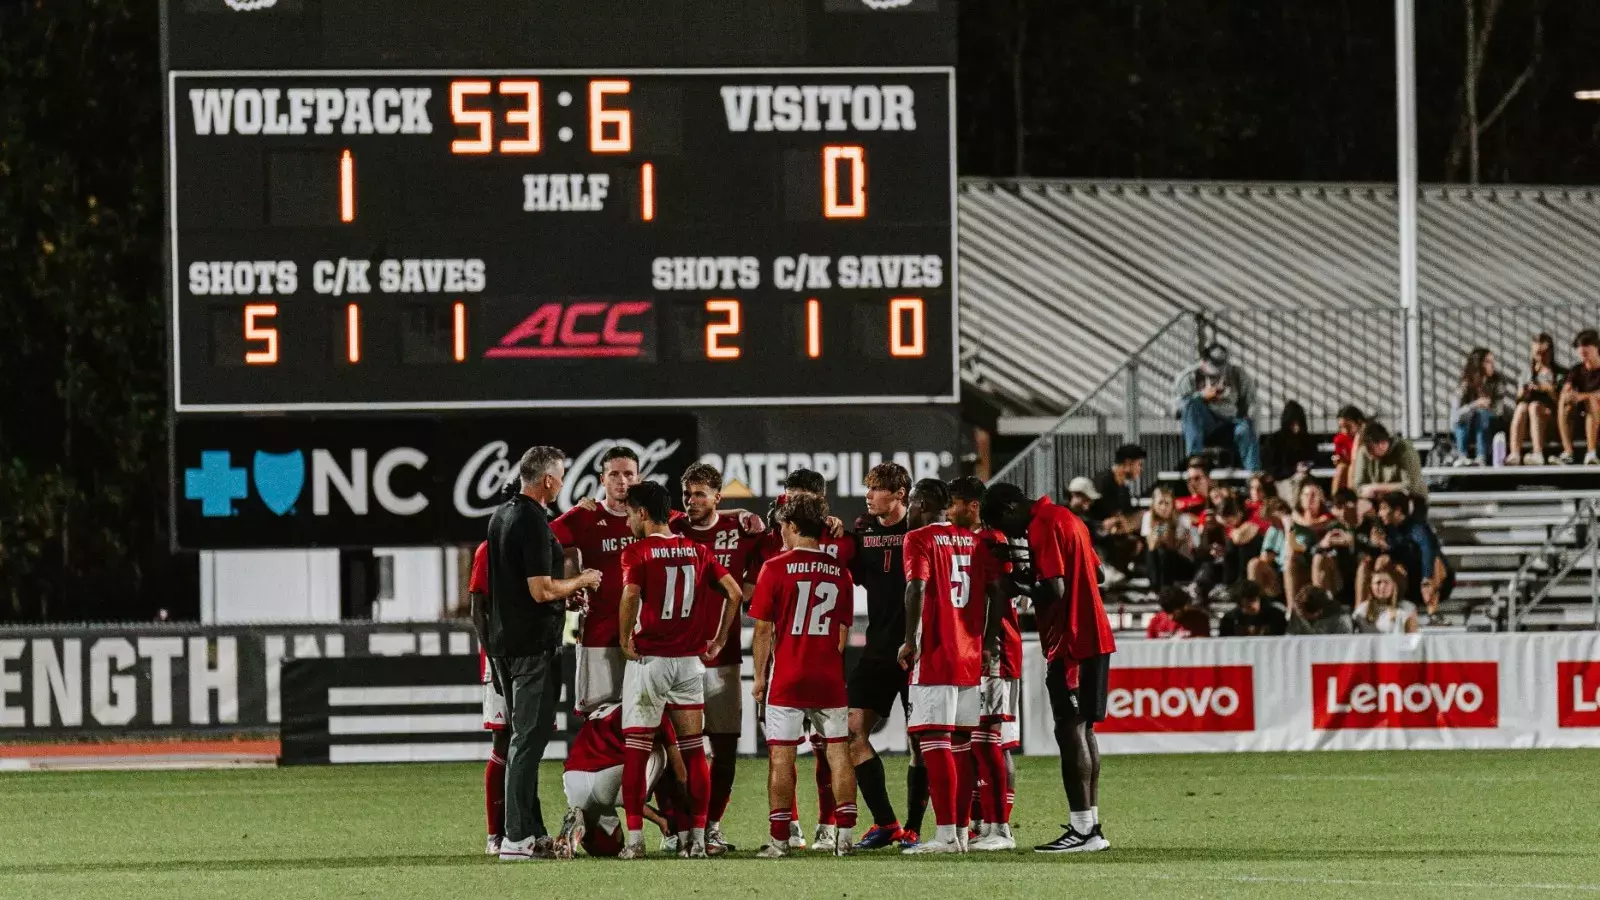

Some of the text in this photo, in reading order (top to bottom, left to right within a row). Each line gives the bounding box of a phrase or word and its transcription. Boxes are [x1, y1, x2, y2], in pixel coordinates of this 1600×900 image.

[189, 88, 433, 135] WOLFPACK
[720, 84, 917, 132] VISITOR
[341, 150, 354, 222] 1
[522, 162, 654, 221] HALF 1
[822, 144, 867, 218] 0
[189, 257, 487, 297] SHOTS C/K SAVES
[652, 253, 943, 293] SHOTS C/K SAVES
[244, 302, 466, 364] 5 1 1
[500, 302, 652, 345] ACC
[705, 297, 925, 359] 2 1 0
[312, 448, 429, 515] NC
[602, 538, 618, 552] NC
[715, 529, 740, 550] 22
[883, 549, 892, 572] 1
[660, 564, 696, 620] 11
[786, 561, 841, 577] WOLFPACK
[950, 554, 971, 609] 5
[791, 581, 839, 636] 12
[0, 636, 239, 728] ENGTH
[1106, 687, 1240, 718] enovo
[1326, 676, 1484, 714] Lenovo
